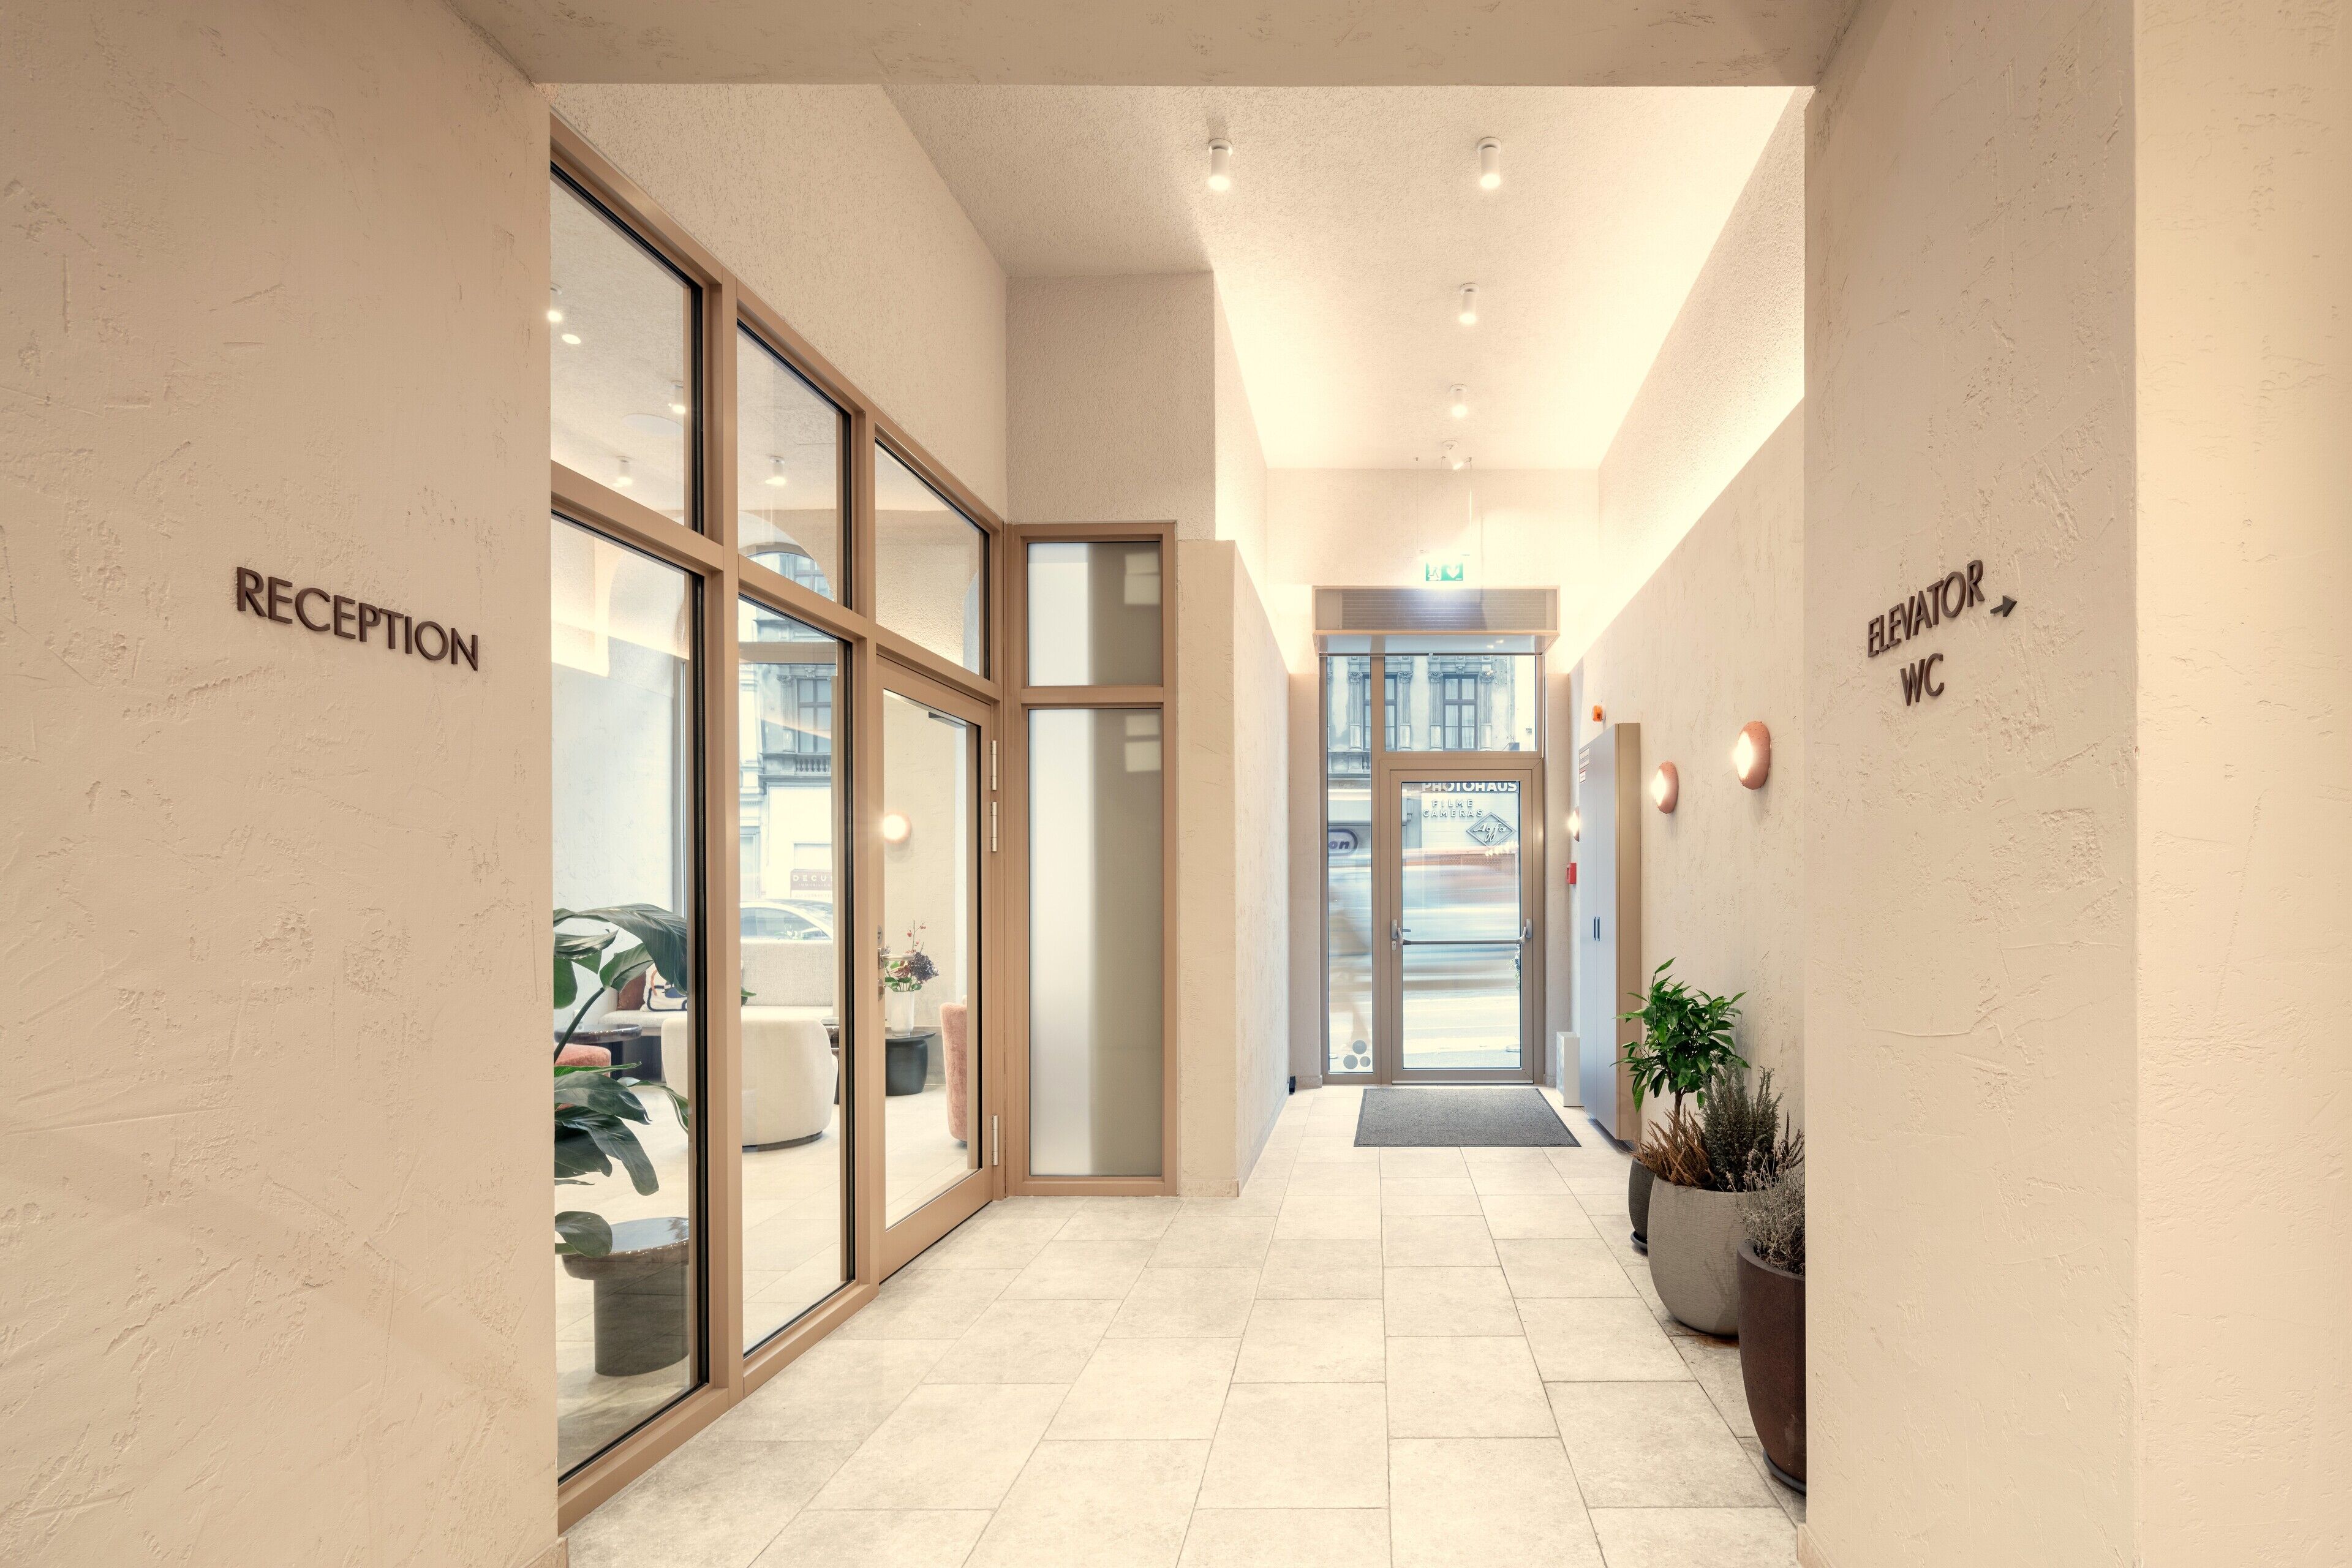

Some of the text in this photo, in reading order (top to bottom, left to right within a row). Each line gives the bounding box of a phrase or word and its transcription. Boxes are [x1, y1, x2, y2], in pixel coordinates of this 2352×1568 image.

[237, 567, 478, 671] RECEPTION
[1868, 559, 1985, 658] ELEVATOR
[1900, 653, 1945, 706] WC
[1423, 809, 1483, 818] CAMERAS
[1472, 823, 1507, 842] Agfa
